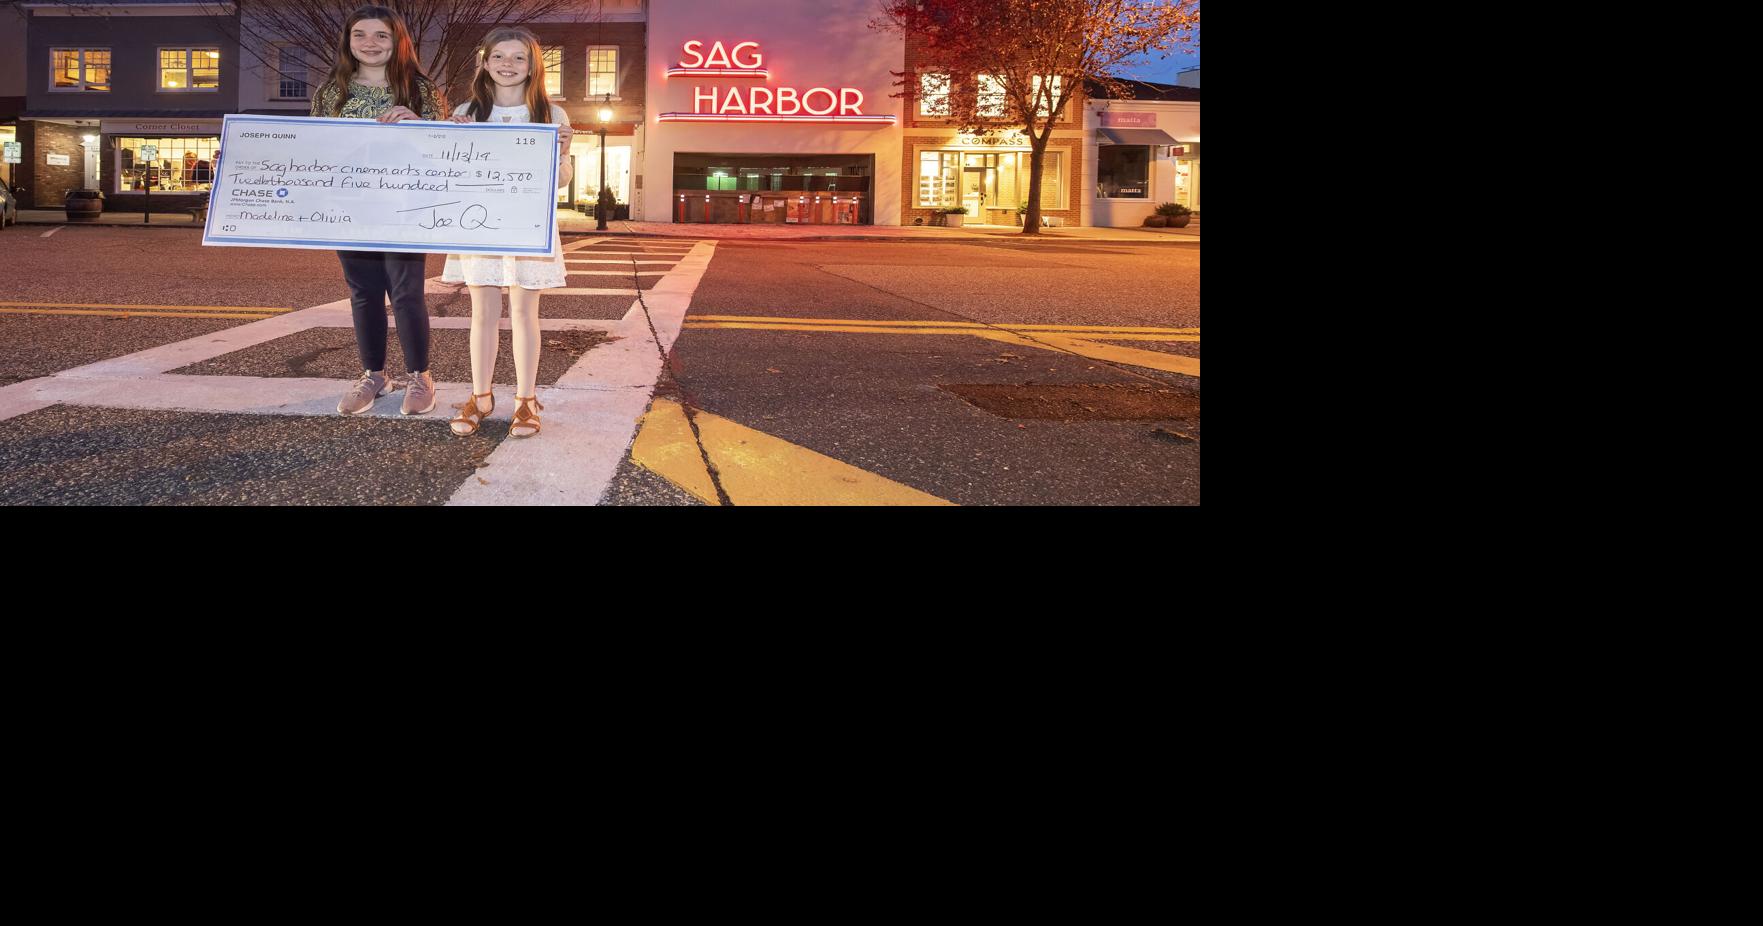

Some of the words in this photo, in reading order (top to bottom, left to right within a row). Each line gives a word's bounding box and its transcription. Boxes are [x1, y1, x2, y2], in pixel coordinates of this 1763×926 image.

[680, 40, 762, 69] SAG
[693, 86, 864, 116] HARBOR
[170, 123, 200, 131] Closet
[514, 137, 535, 146] 118
[961, 137, 1023, 145] COMPASS
[260, 159, 287, 178] Sag
[391, 163, 420, 176] arts
[379, 177, 449, 191] hundred
[231, 189, 273, 198] CHASE
[240, 210, 295, 221] Madeline
[310, 210, 352, 223] Olivia
